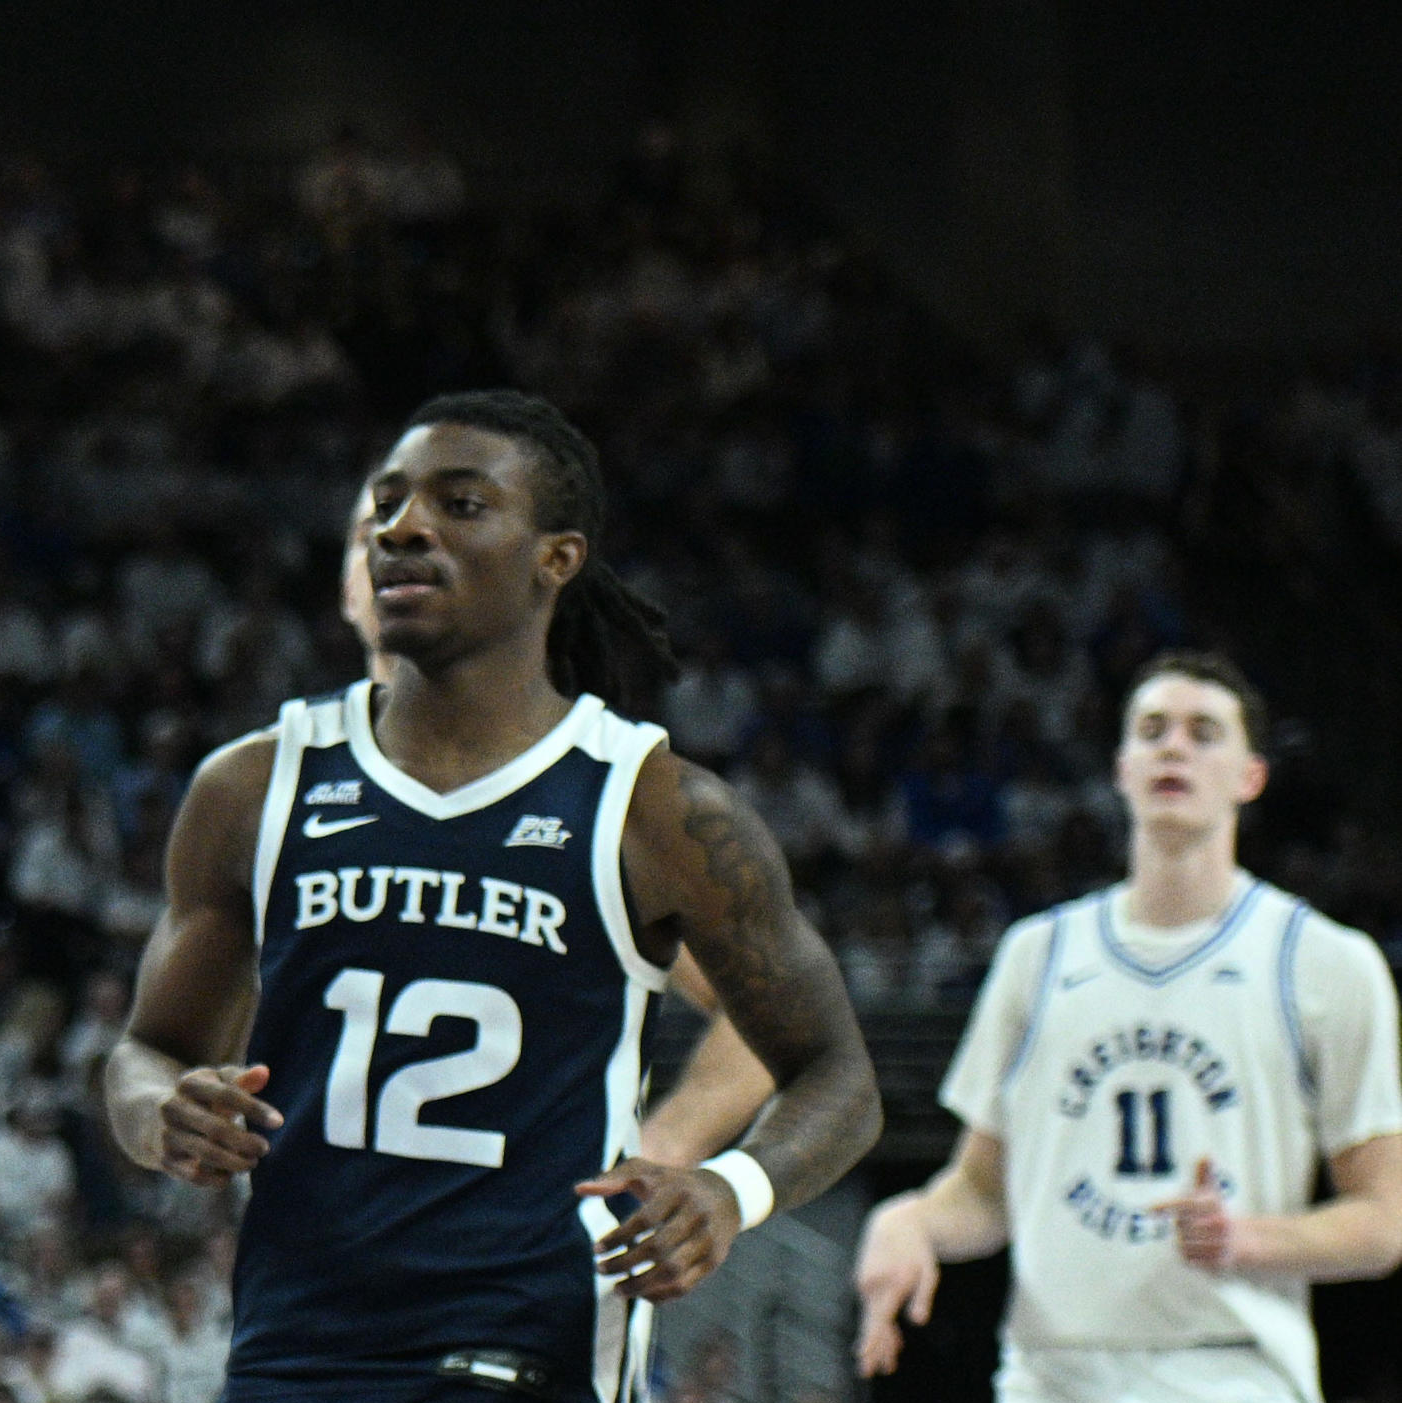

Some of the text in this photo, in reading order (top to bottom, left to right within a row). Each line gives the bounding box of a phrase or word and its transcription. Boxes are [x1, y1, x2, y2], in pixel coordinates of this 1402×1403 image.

[294, 865, 568, 955] BUTLER
[323, 967, 522, 1168] 12
[1114, 1088, 1176, 1177] 11
